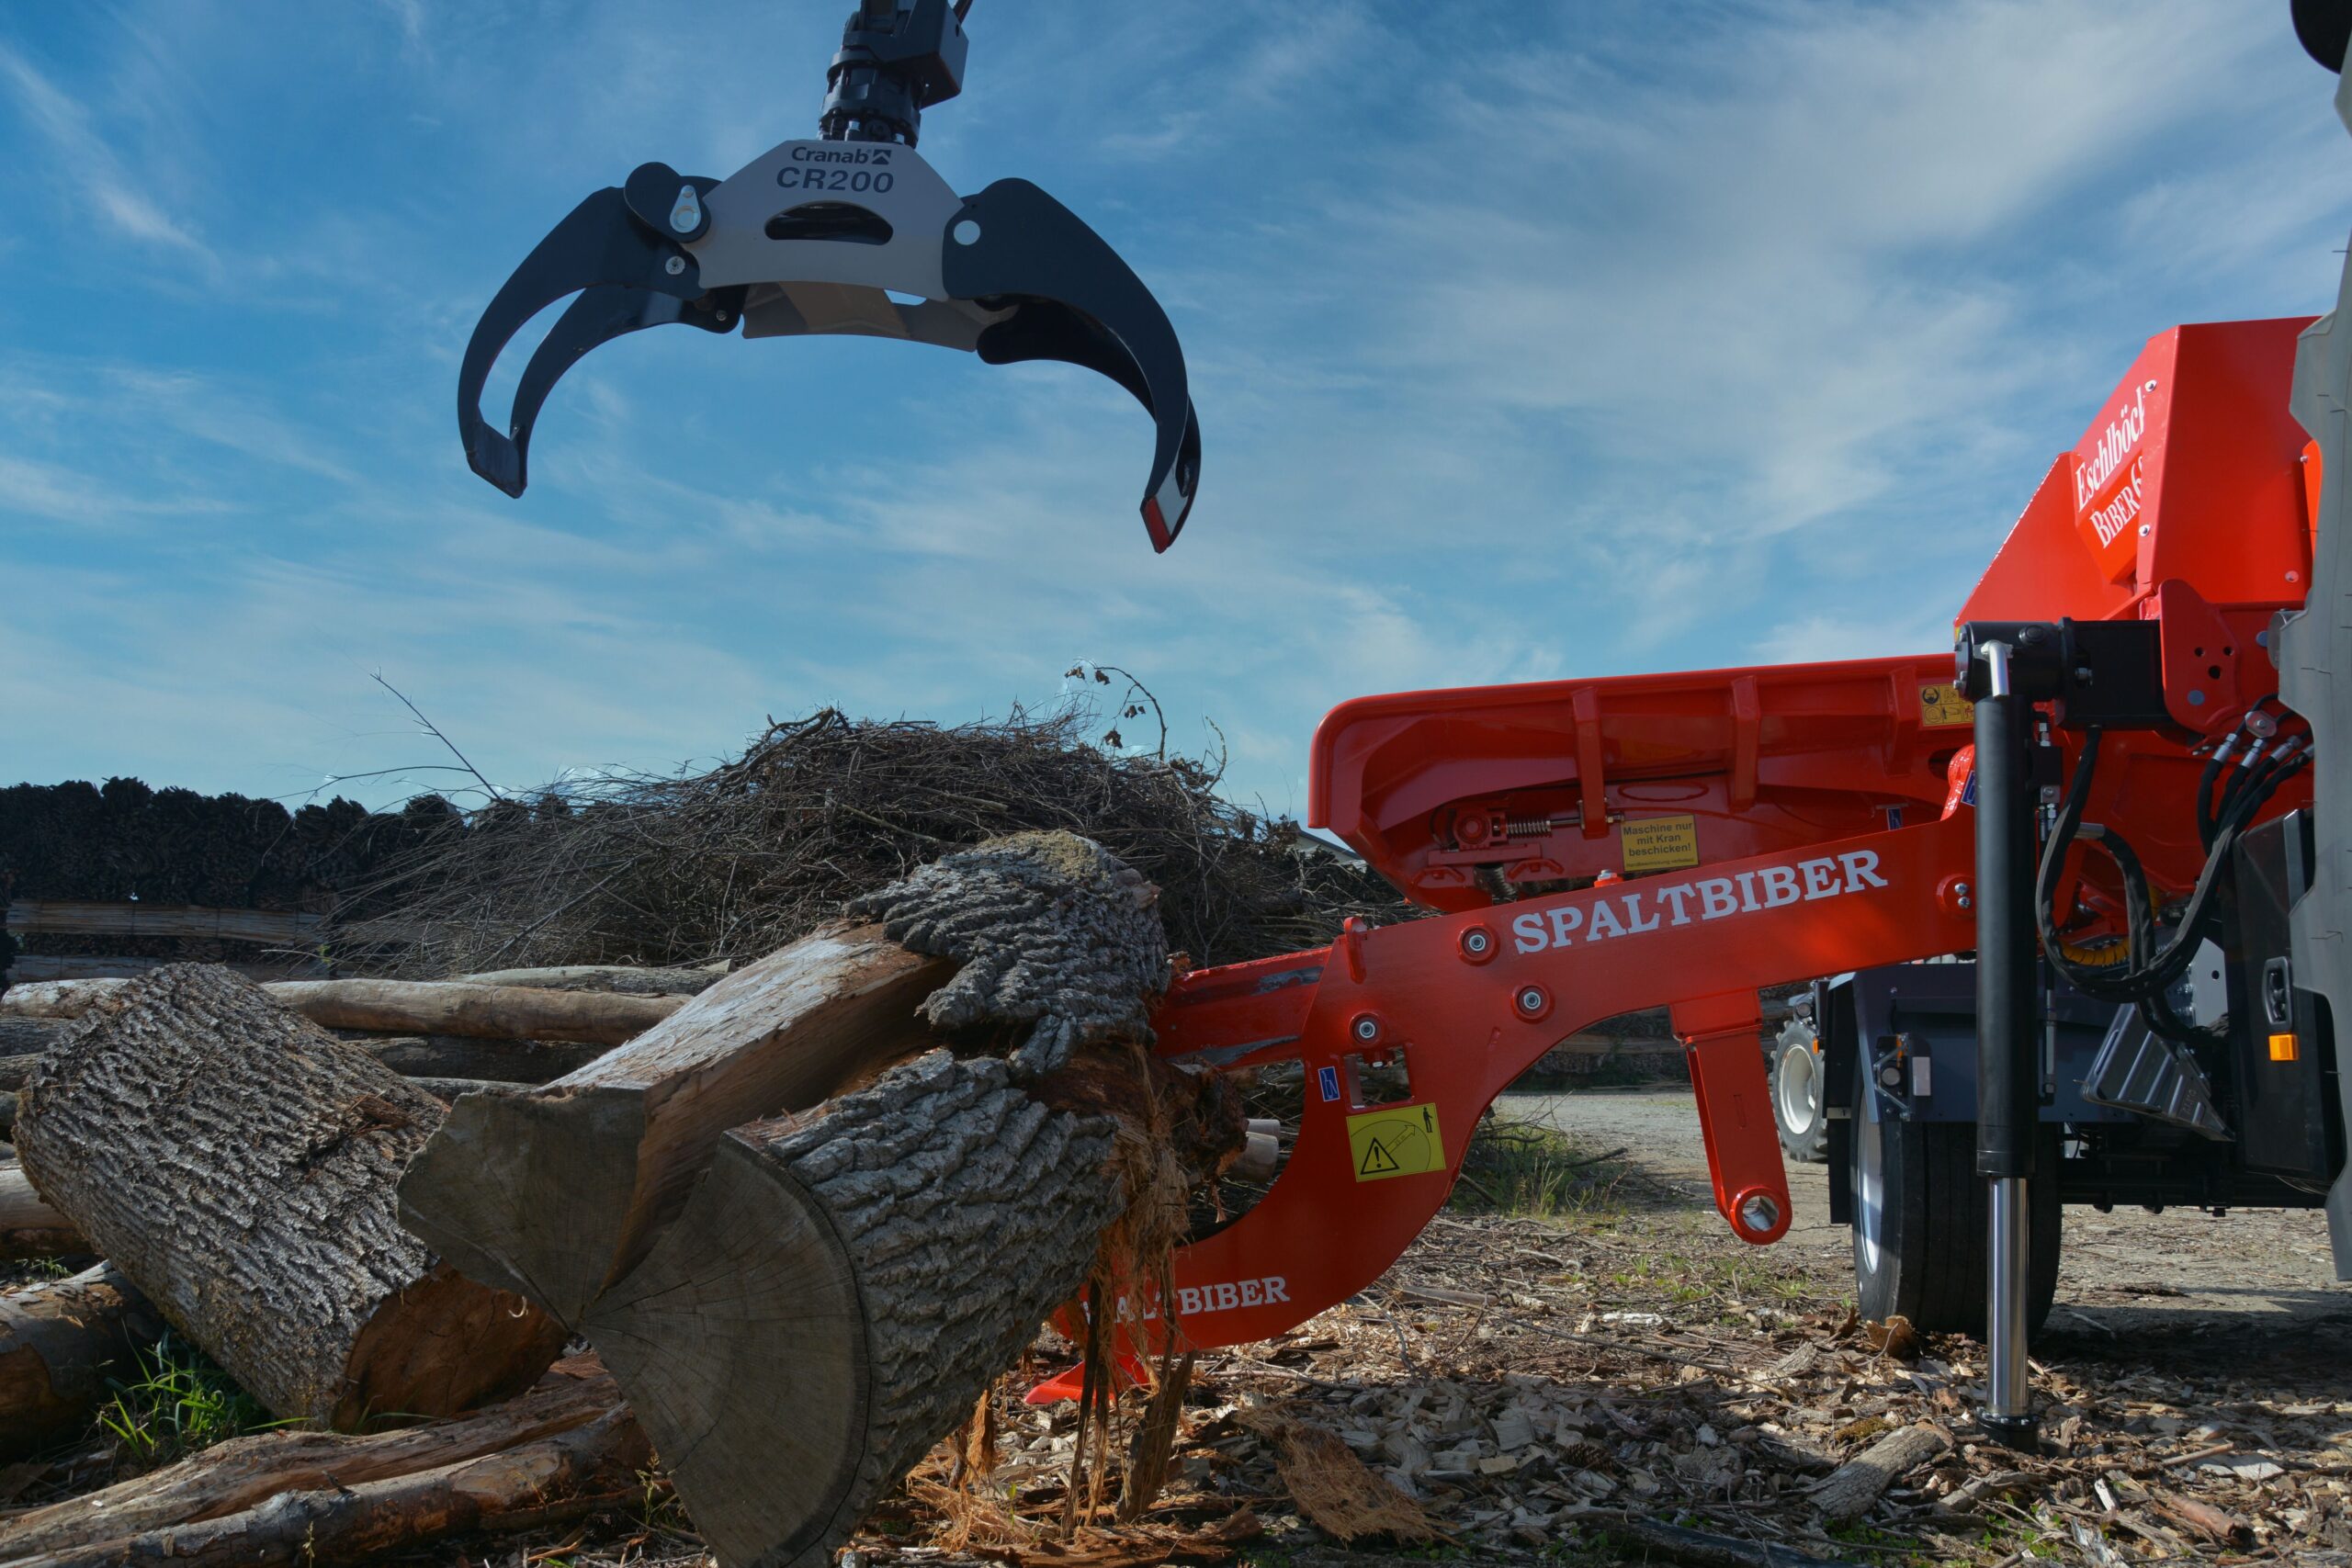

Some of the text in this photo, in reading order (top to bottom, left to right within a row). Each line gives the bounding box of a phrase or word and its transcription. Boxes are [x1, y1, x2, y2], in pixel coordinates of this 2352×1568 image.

[791, 146, 869, 164] Cranab
[776, 166, 894, 193] CR200
[1623, 822, 1692, 836] Maschine nur
[1637, 833, 1681, 845] mit Kran
[1629, 843, 1691, 856] beschicken!
[1512, 850, 1888, 954] SPALTBIBER
